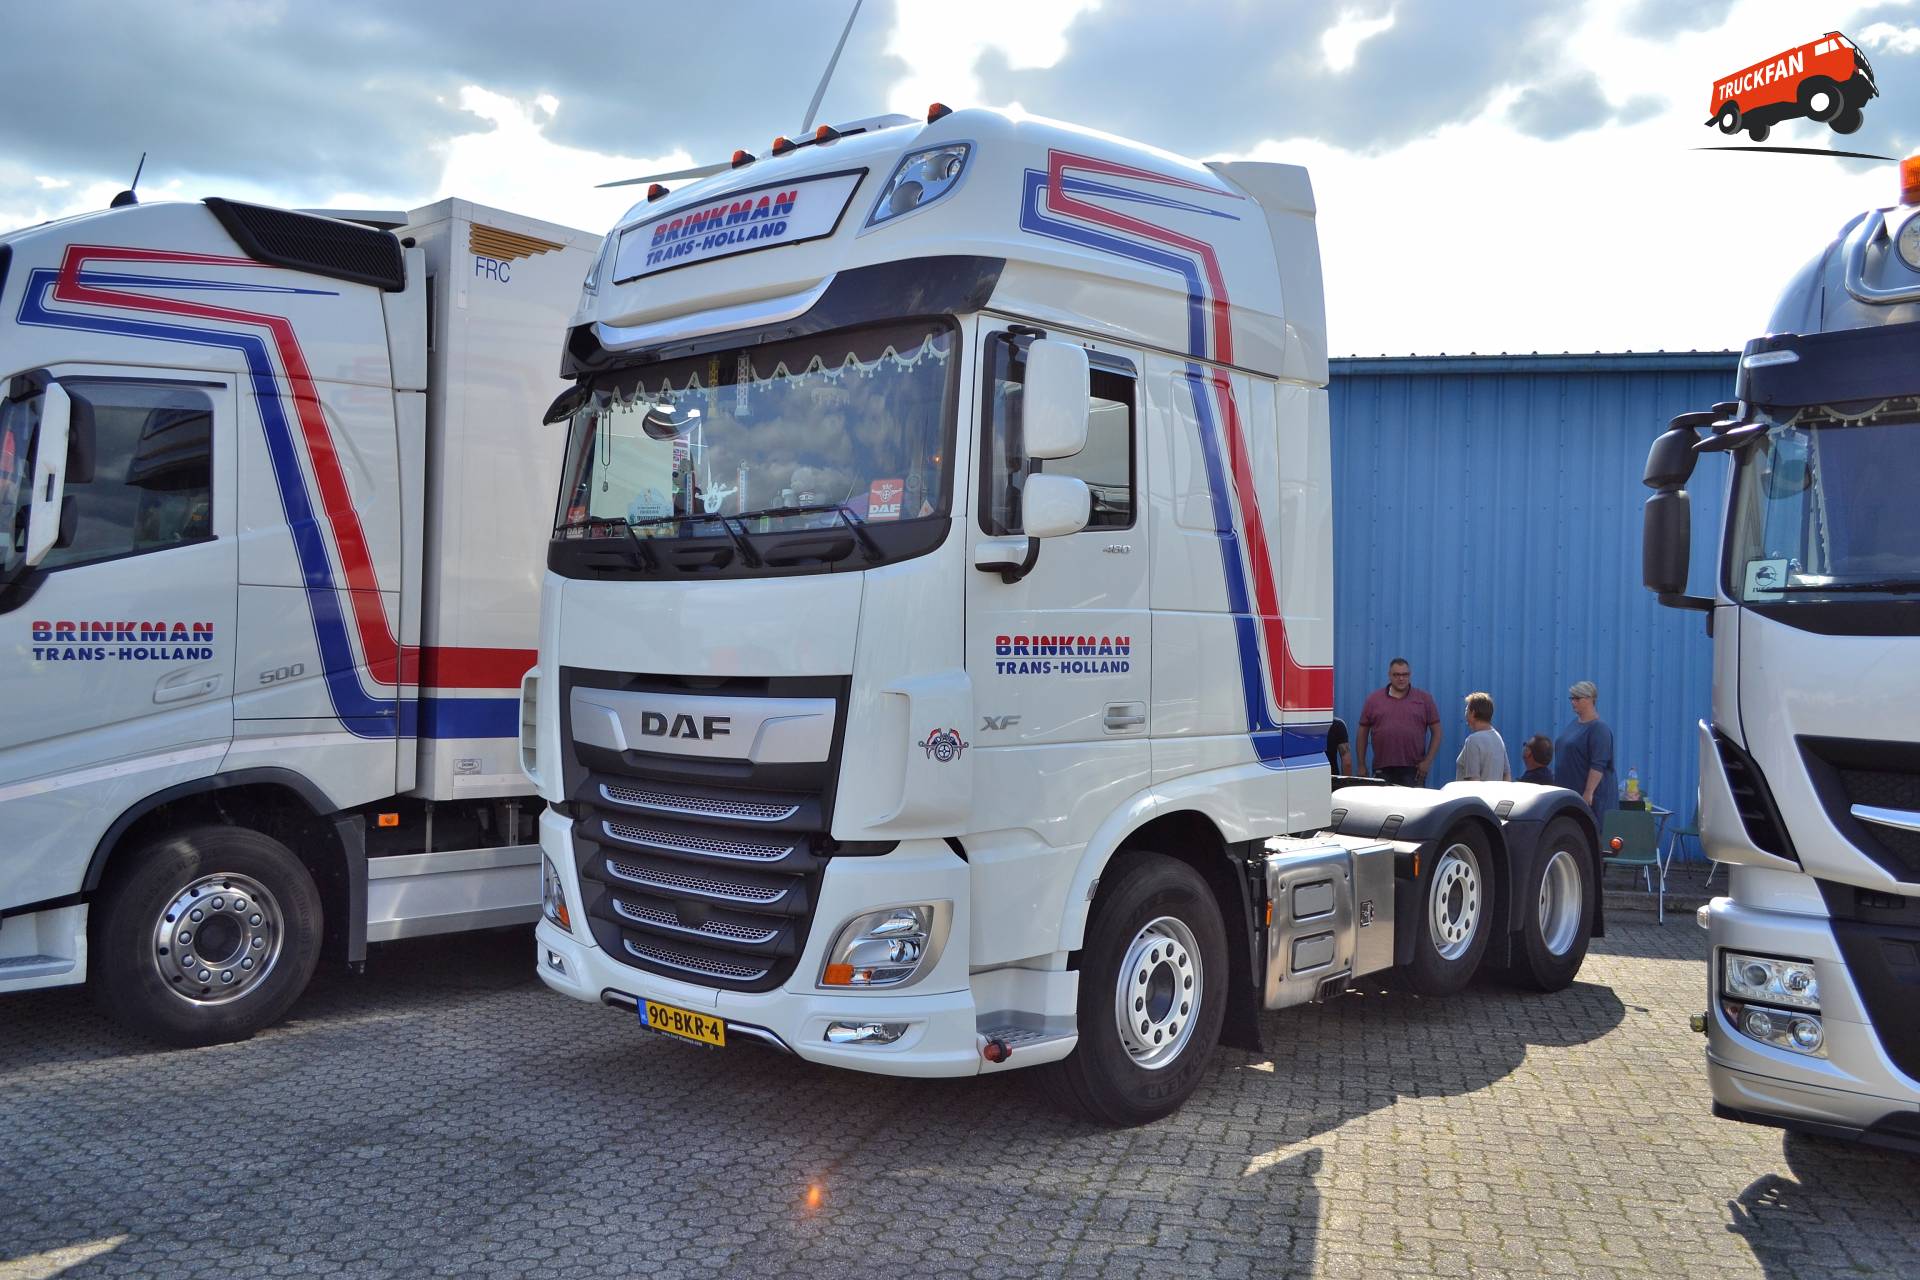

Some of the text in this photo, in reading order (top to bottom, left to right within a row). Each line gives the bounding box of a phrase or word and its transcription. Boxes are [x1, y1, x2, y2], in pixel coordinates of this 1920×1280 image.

[651, 190, 798, 247] BRINKMAN
[646, 221, 787, 266] TRANS-HOLLAND
[475, 255, 511, 283] FRC
[869, 503, 901, 514] DAF
[32, 621, 214, 642] BRINKMAN
[32, 647, 213, 661] TRANS-HOLLAND
[995, 635, 1130, 656] BRINKMAN
[260, 663, 305, 685] 500
[995, 661, 1130, 675] TRANS-HOLLAND
[641, 711, 731, 740] DAF
[980, 714, 1022, 732] XF
[649, 1005, 720, 1041] 90-BKR-4
